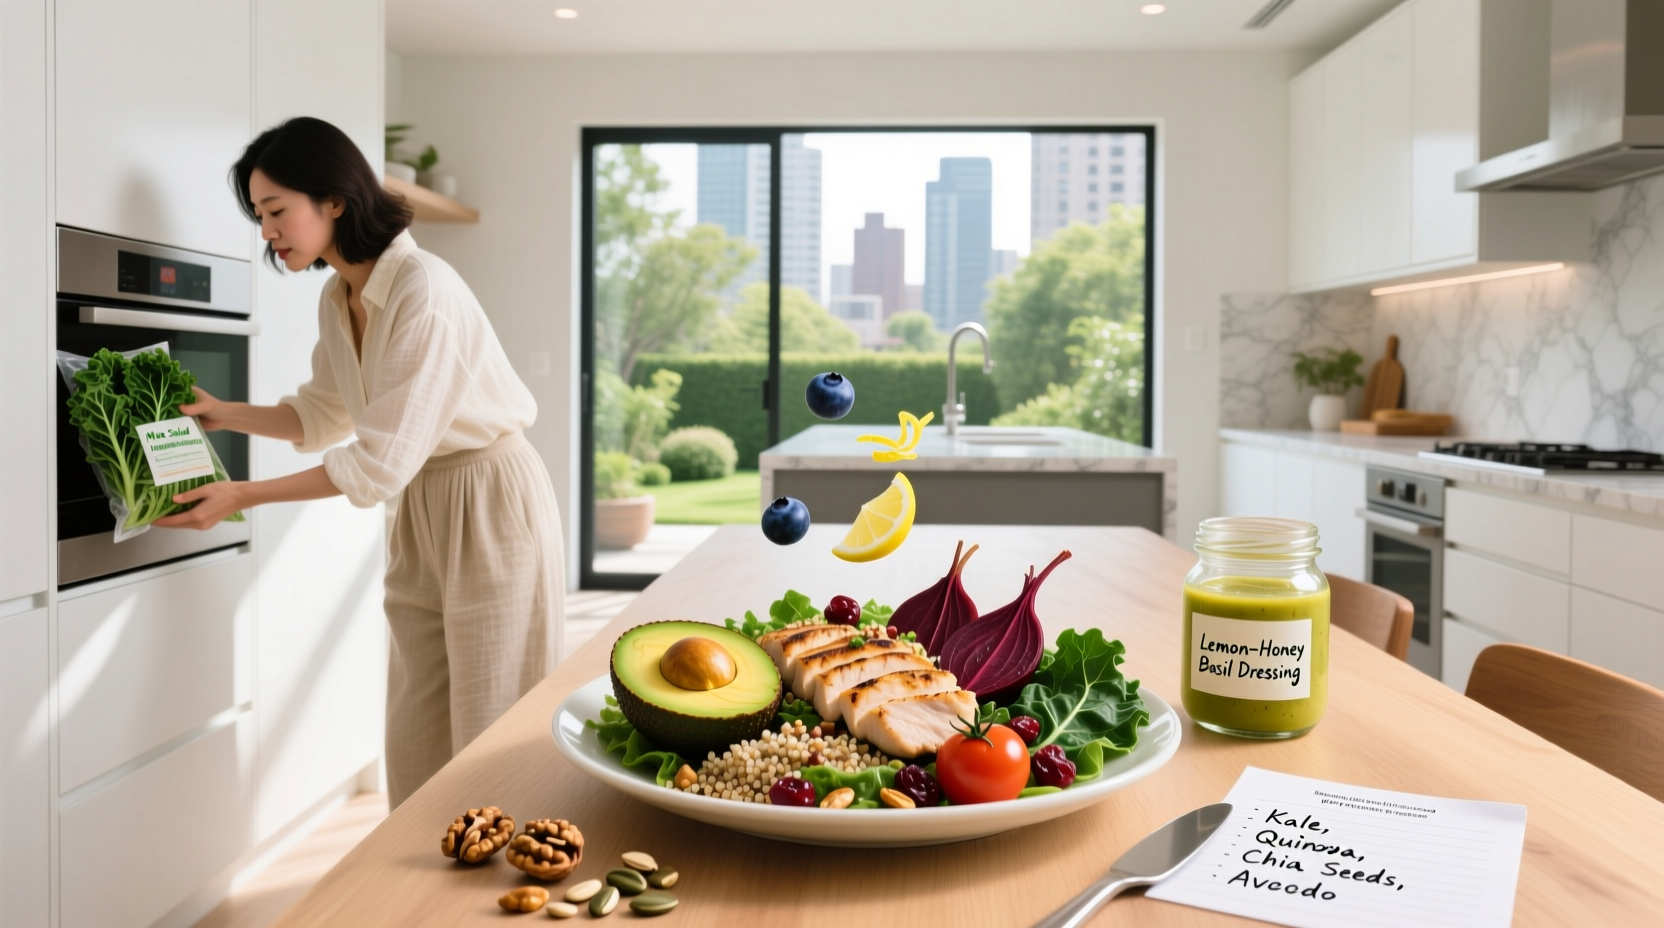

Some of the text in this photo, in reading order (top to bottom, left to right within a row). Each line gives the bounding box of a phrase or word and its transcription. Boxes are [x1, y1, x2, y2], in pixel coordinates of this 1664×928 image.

[1200, 632, 1305, 662] Lemon-Honey
[1198, 655, 1301, 687] Basil Dressing
[1265, 808, 1329, 835] Kale,
[1242, 849, 1404, 891] Chia Seeds,
